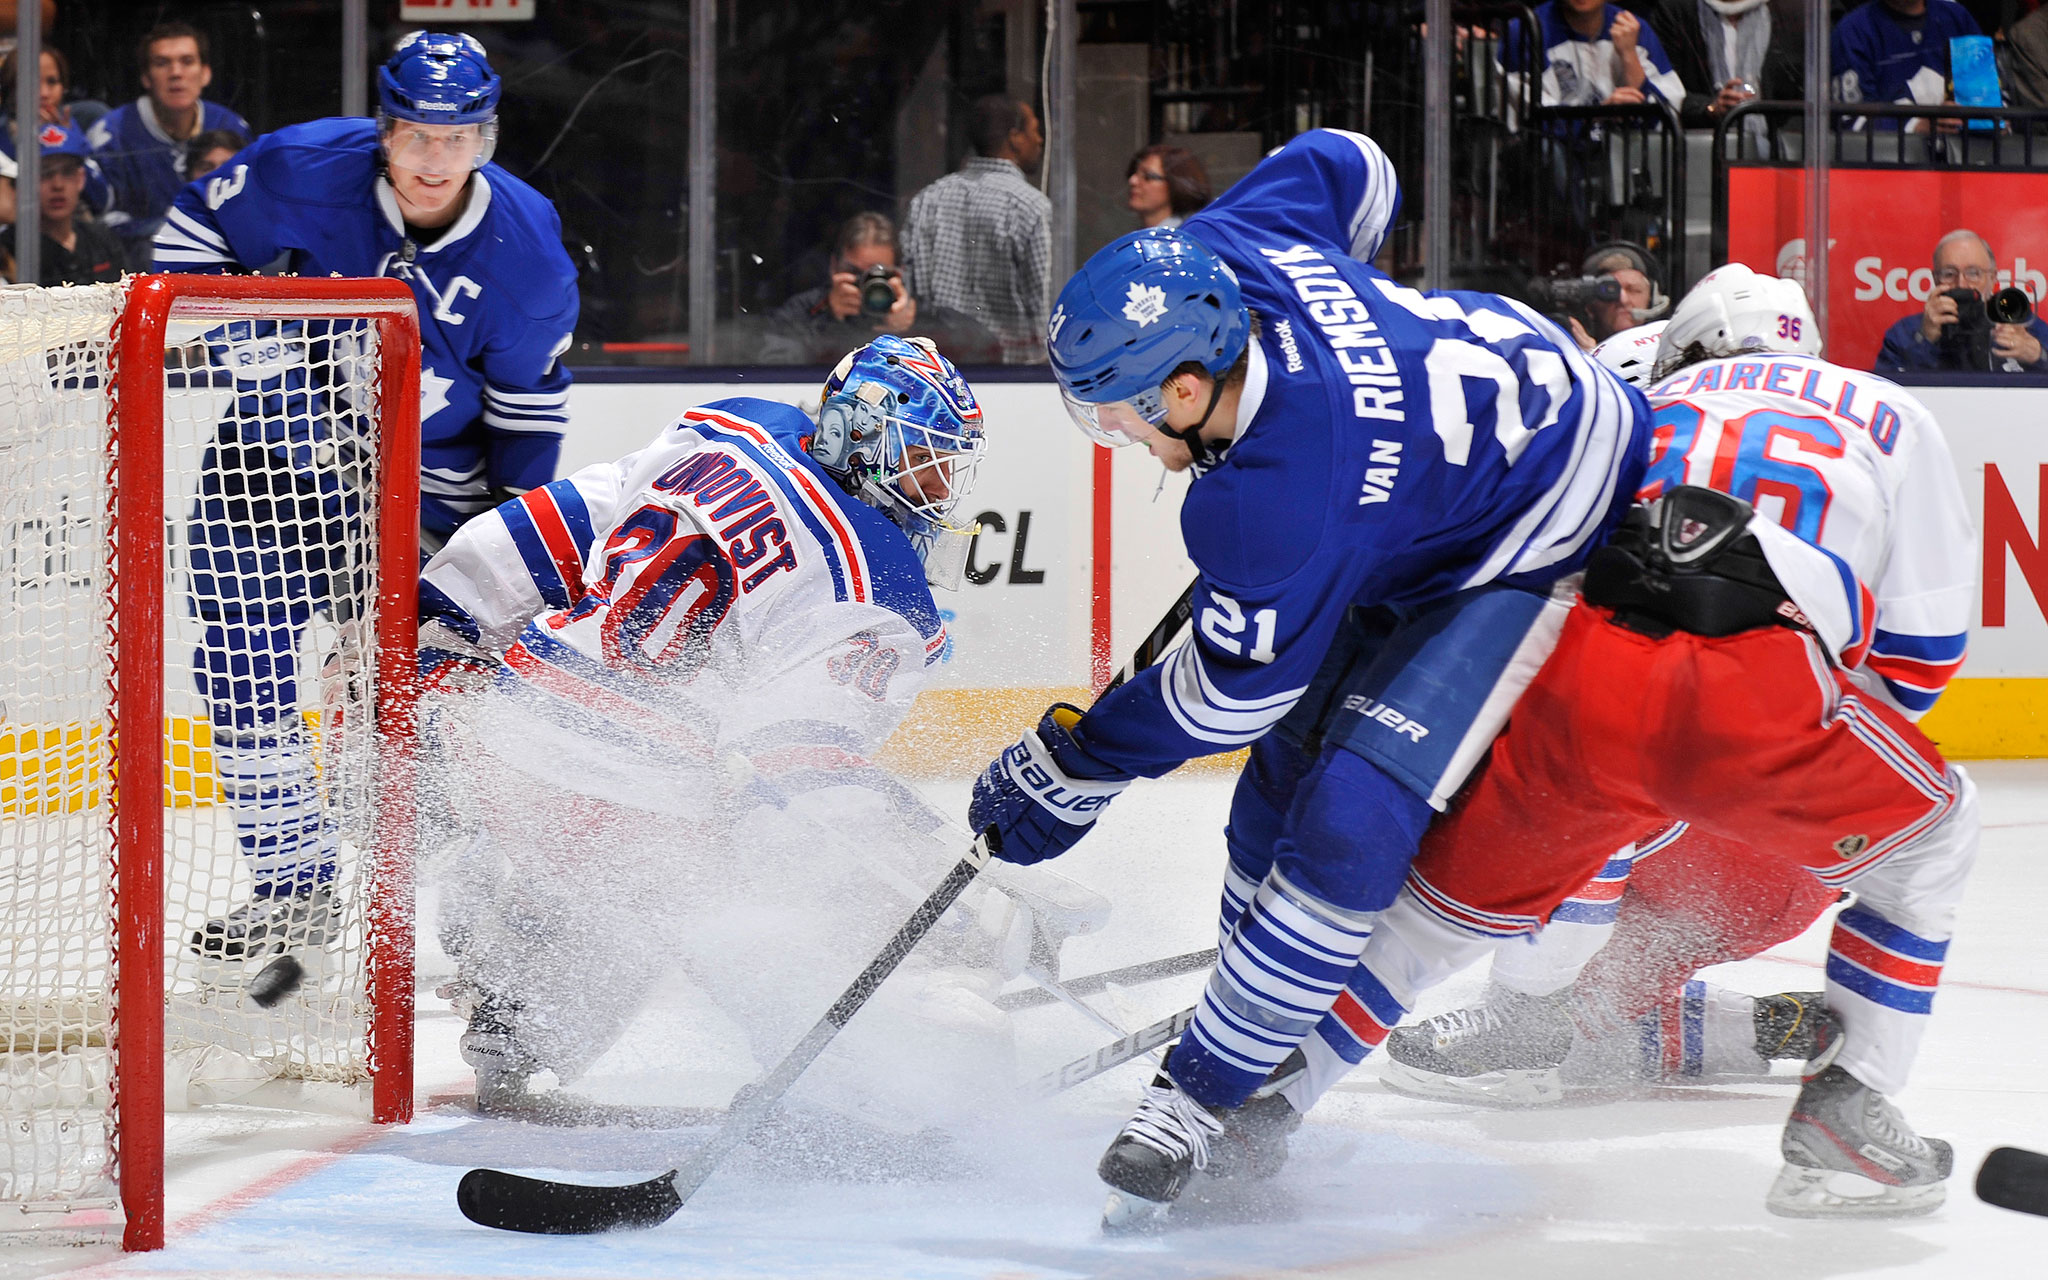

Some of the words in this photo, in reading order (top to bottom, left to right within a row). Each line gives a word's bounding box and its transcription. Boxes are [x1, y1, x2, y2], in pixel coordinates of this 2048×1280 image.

[418, 100, 458, 112] Reebok
[207, 163, 249, 212] 3
[433, 275, 483, 326] C
[1777, 314, 1803, 342] 36
[1259, 244, 1406, 422] RIEMSDYK
[1274, 319, 1304, 374] Reebok
[1645, 363, 1901, 456] CARELLO
[1358, 438, 1403, 506] VAN
[1640, 399, 1847, 545] 36
[928, 510, 1046, 586] CL
[1200, 590, 1278, 665] 21
[1341, 694, 1430, 743] AUER
